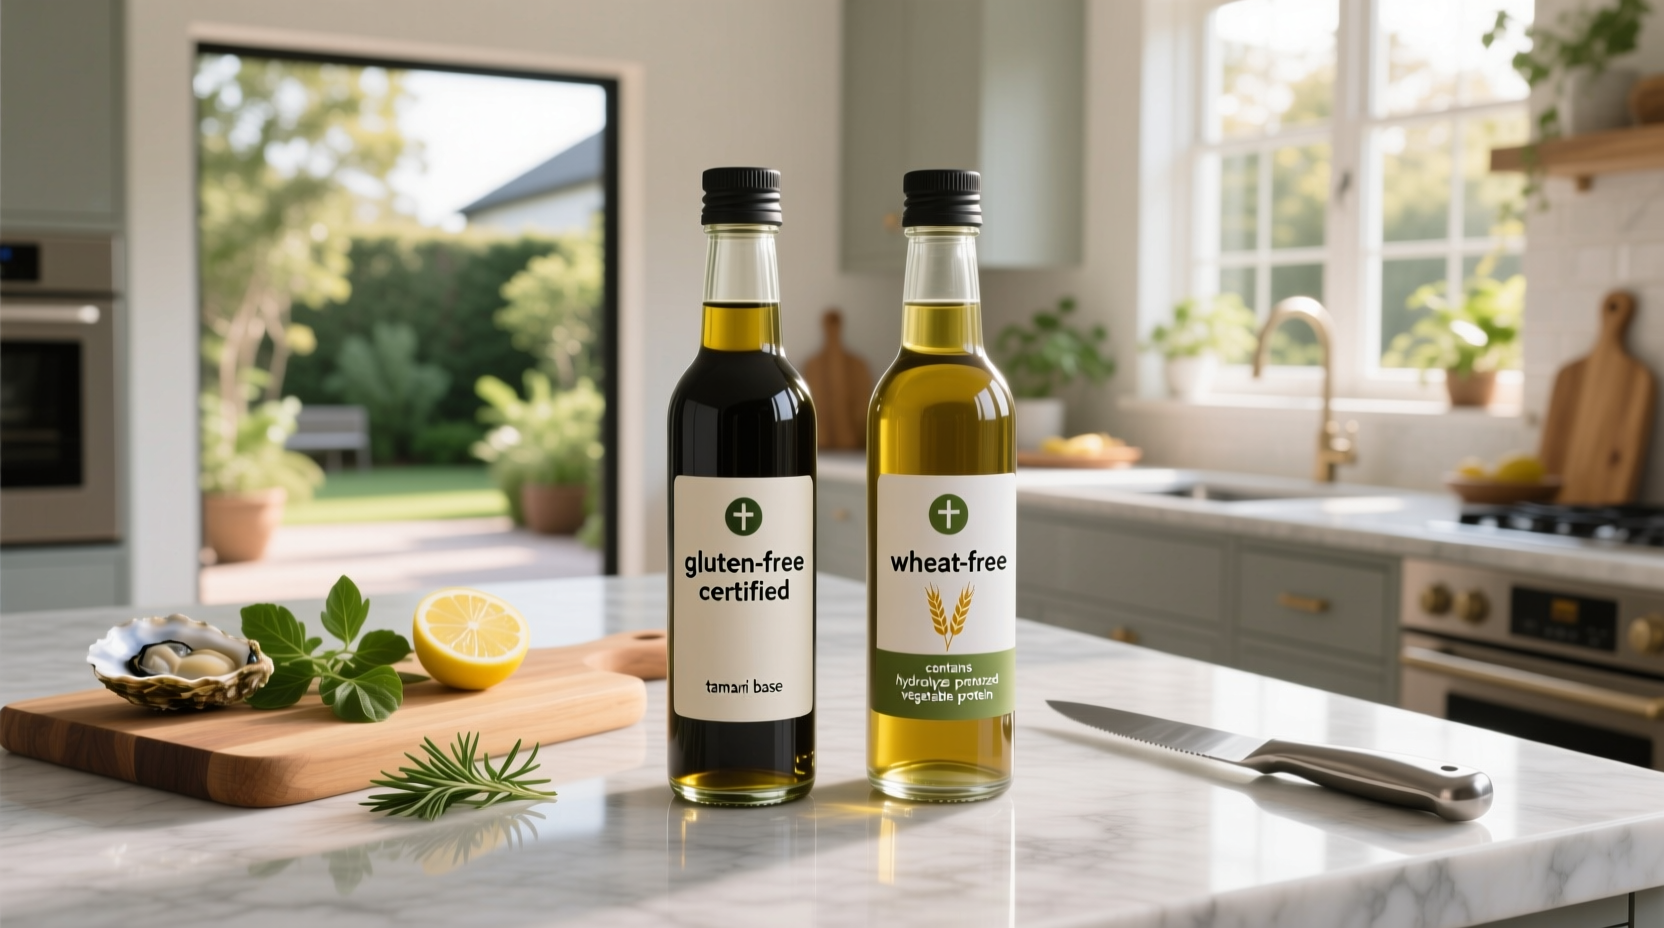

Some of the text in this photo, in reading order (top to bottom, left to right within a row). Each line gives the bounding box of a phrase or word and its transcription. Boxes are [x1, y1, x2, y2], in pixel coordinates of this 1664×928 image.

[685, 550, 804, 578] gluten-free
[890, 550, 1007, 573] wheat-free
[699, 579, 789, 601] certified
[753, 679, 783, 693] base
